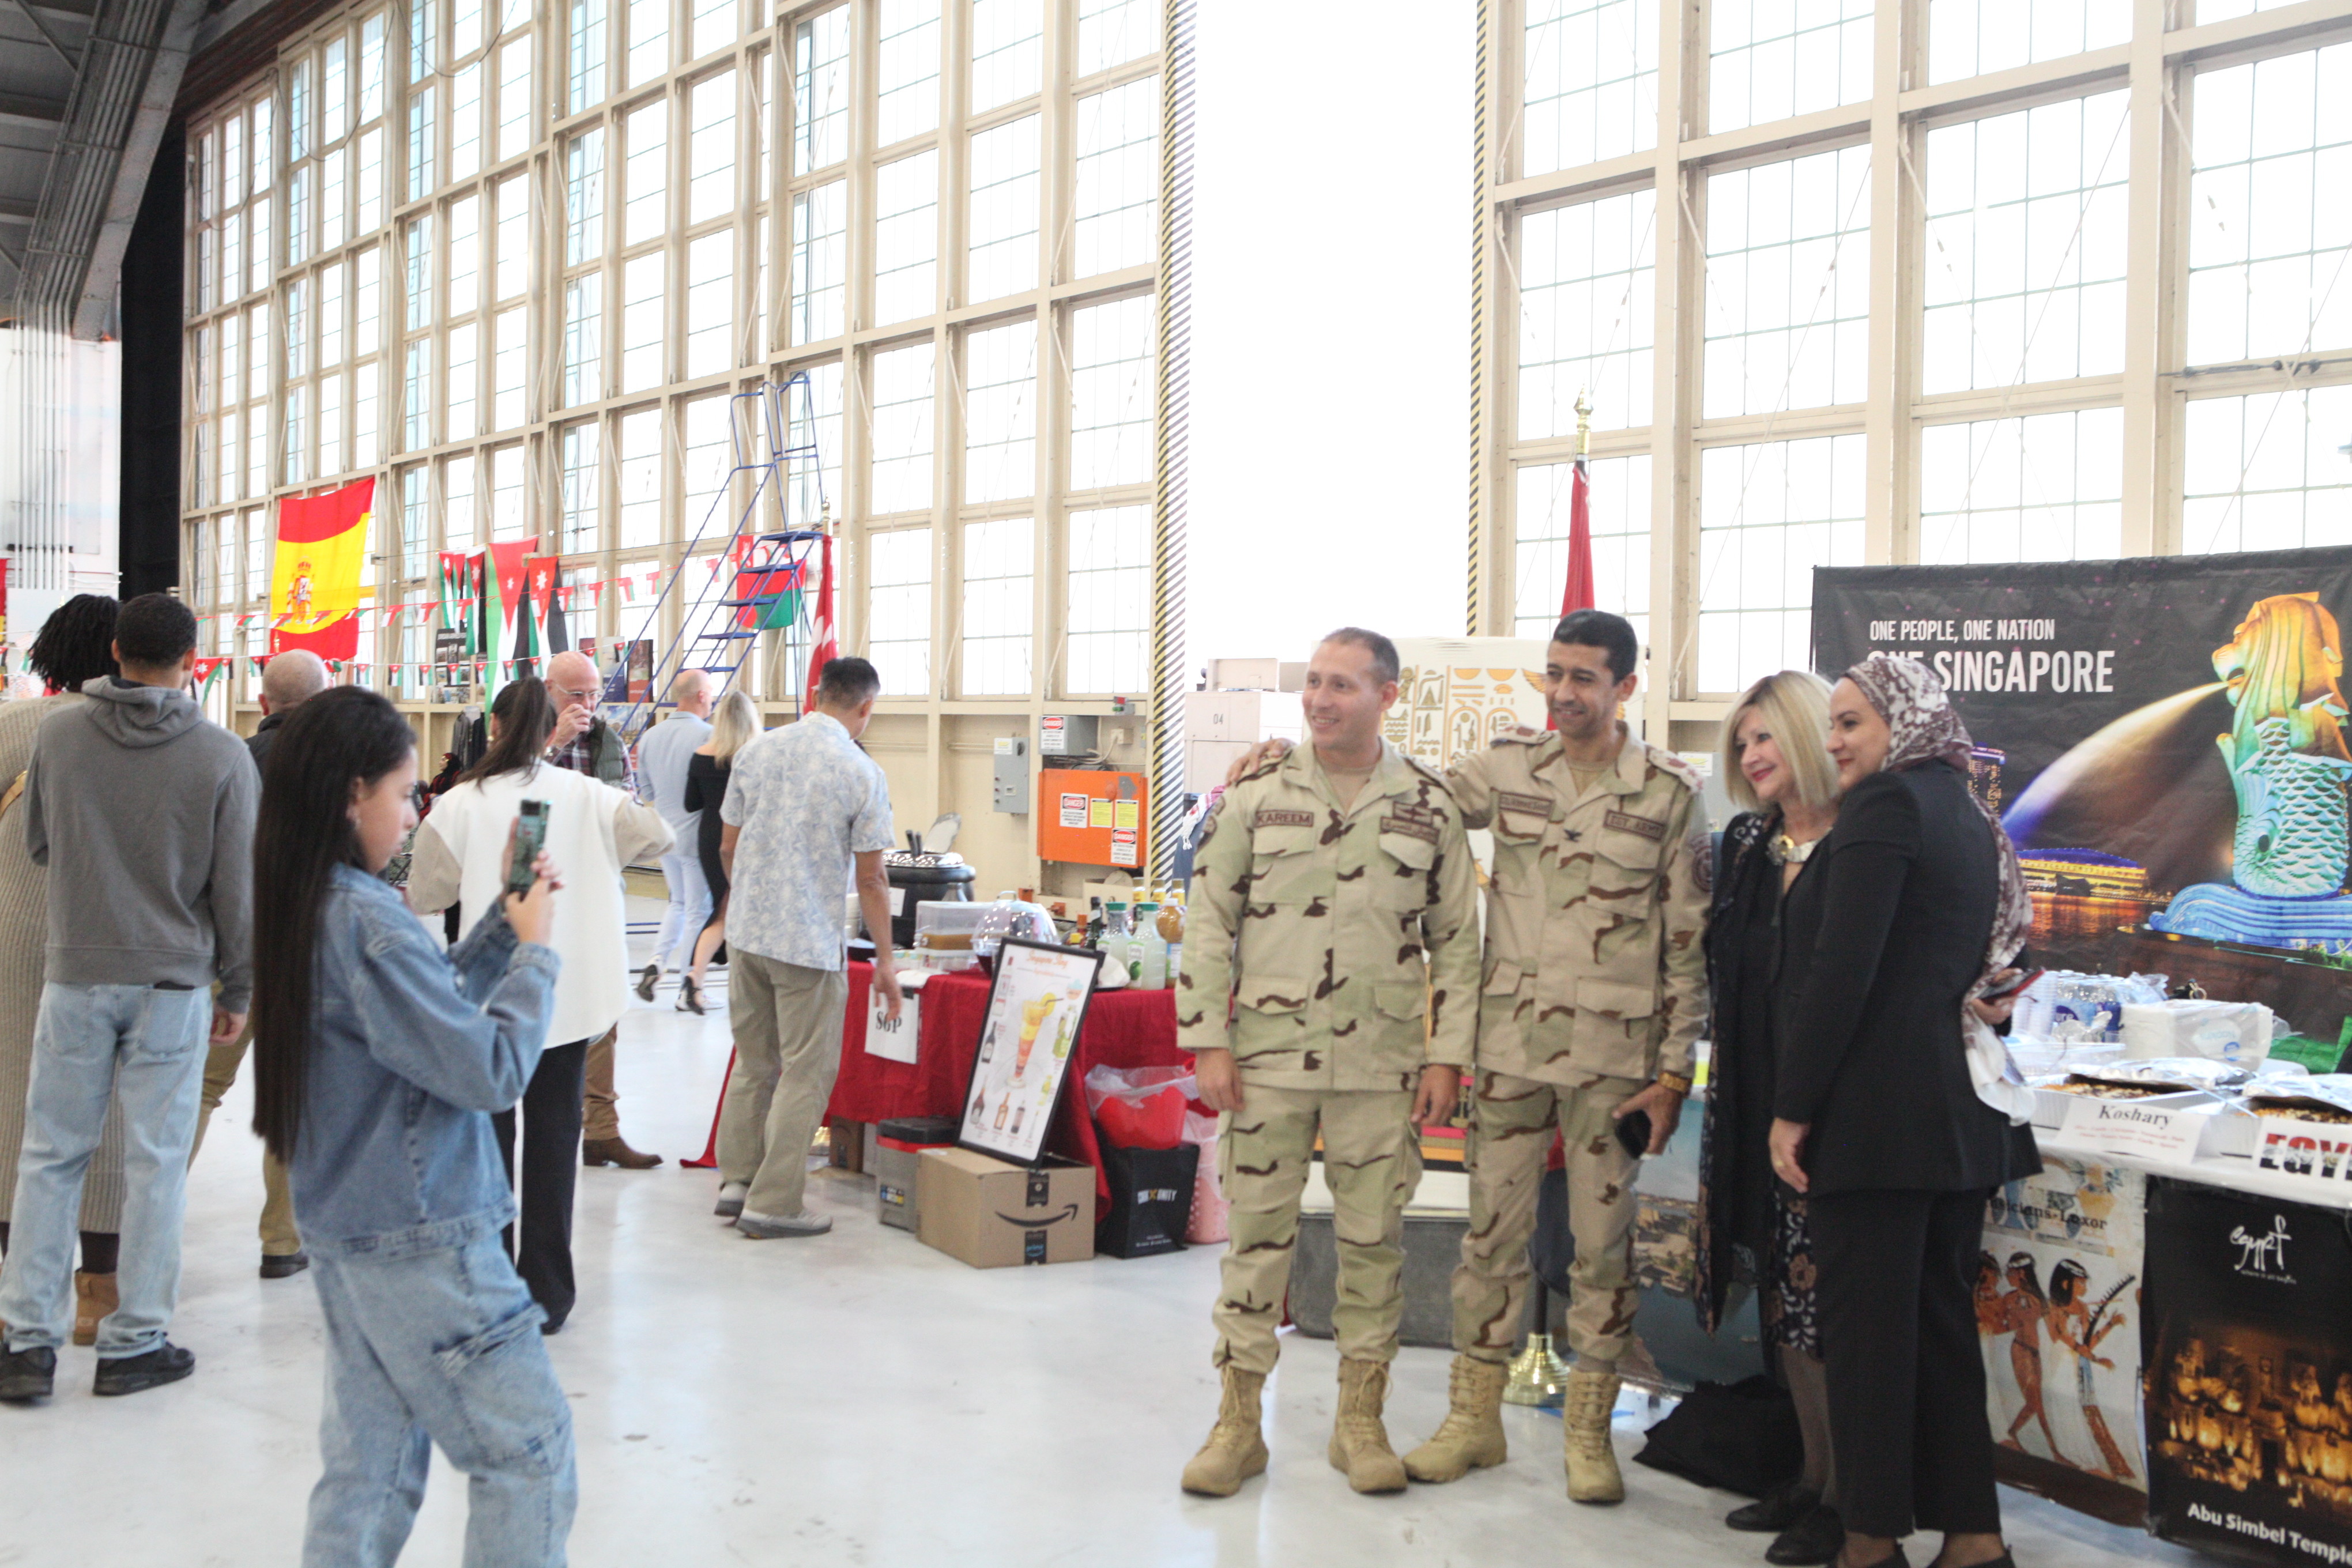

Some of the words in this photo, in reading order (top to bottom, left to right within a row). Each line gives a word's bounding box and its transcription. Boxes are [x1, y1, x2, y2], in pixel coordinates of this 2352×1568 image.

[1869, 620, 1897, 641] ONE
[1900, 620, 1959, 643] PEOPLE,
[1963, 620, 1992, 641] ONE
[1996, 619, 2055, 640] NATION
[1933, 650, 2115, 693] SINGAPORE
[1213, 714, 1224, 725] 04
[1257, 813, 1311, 824] KAREEM
[2099, 1105, 2173, 1130] Koshary
[2187, 1503, 2222, 1526] Abu
[2226, 1513, 2285, 1545] Simbel
